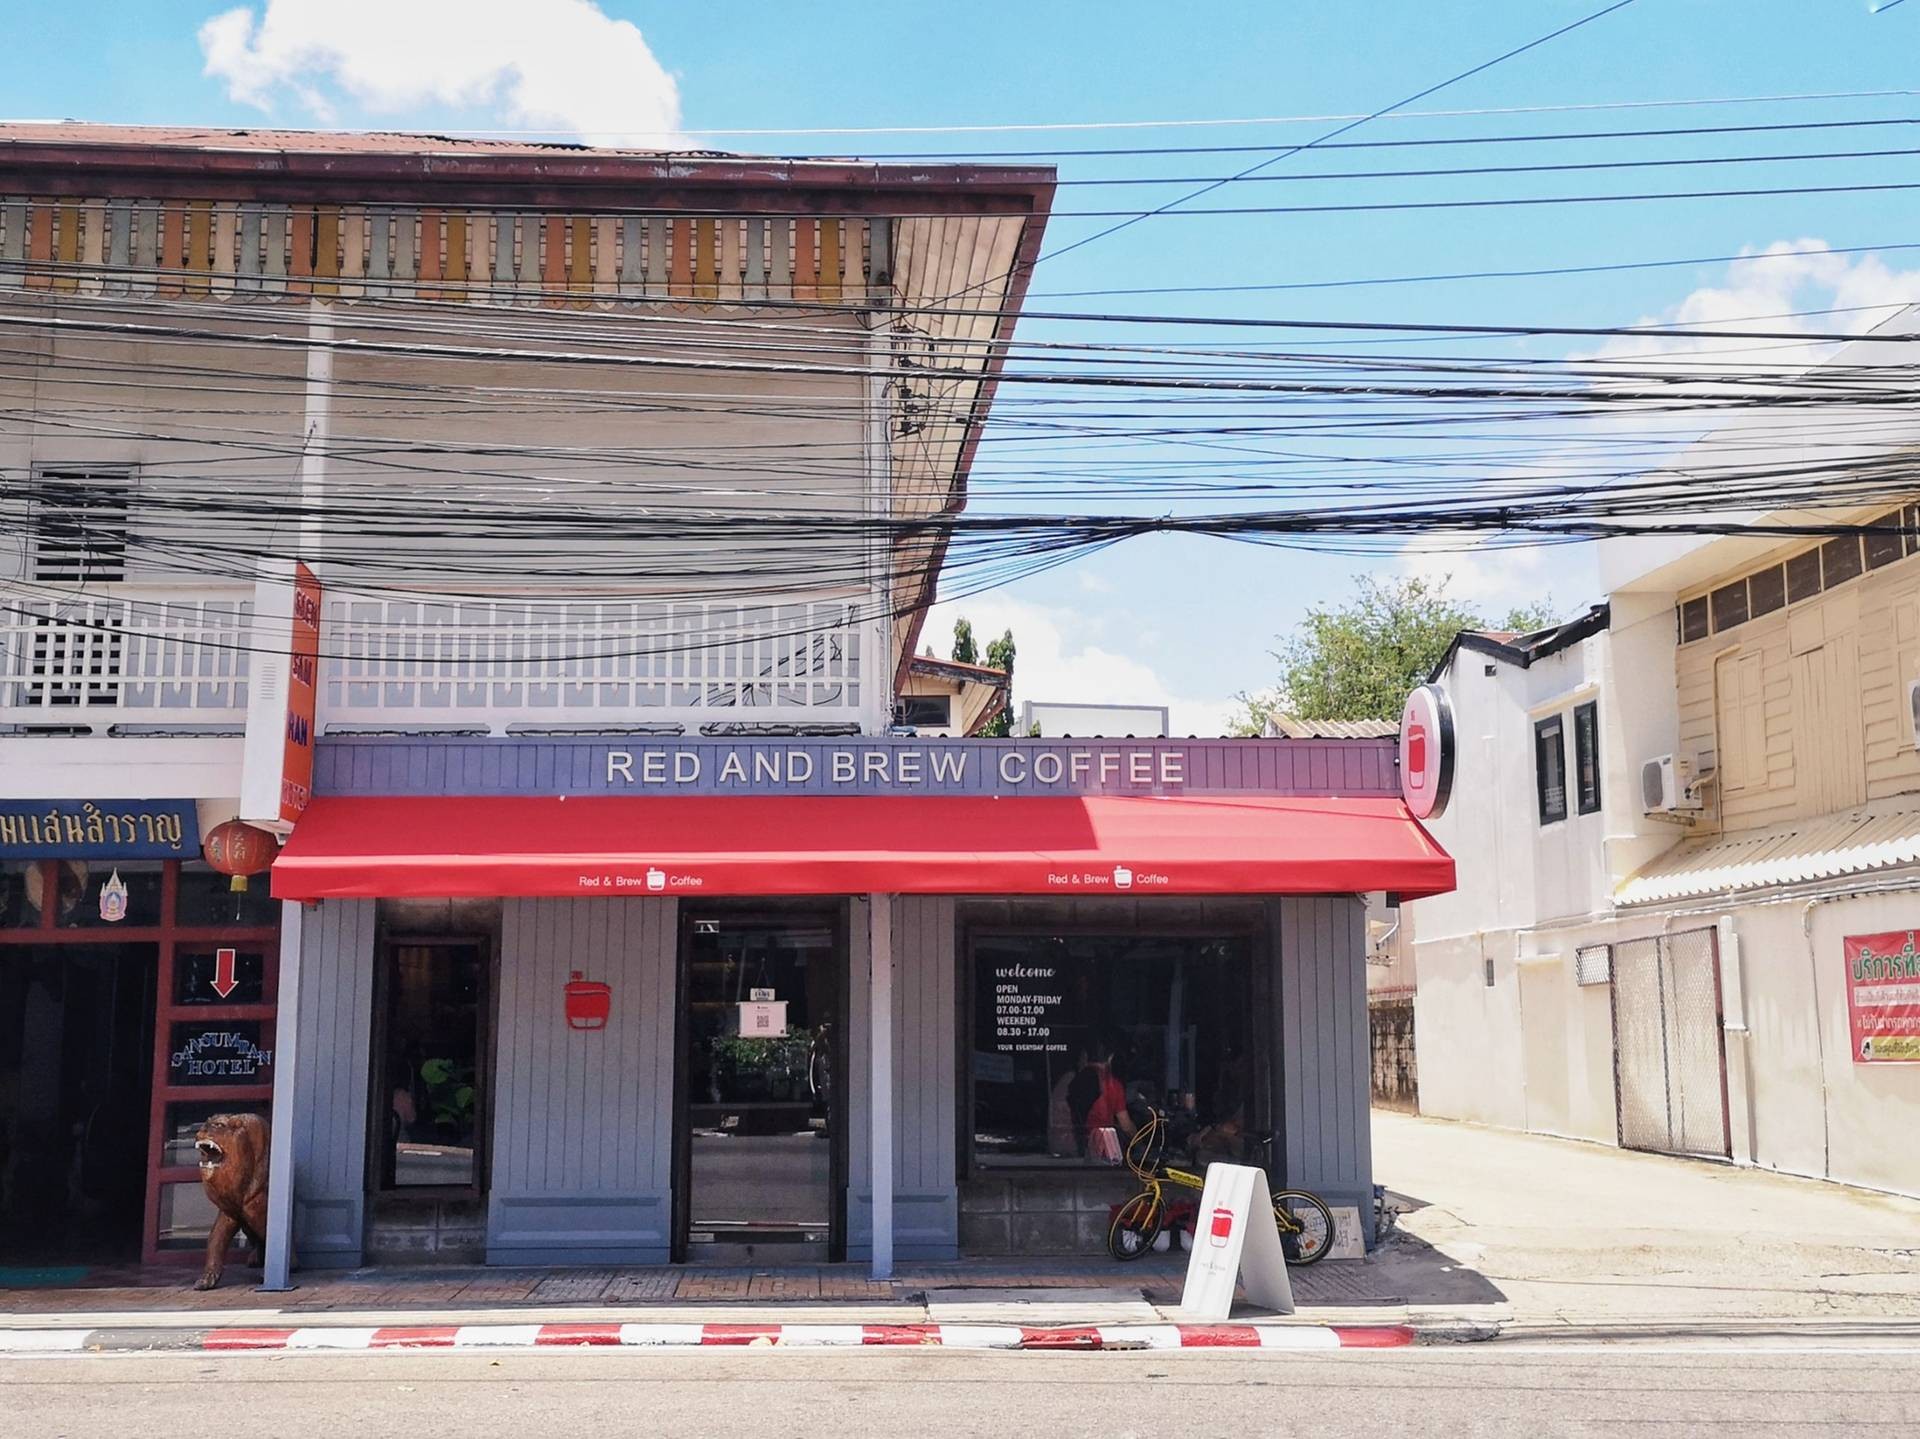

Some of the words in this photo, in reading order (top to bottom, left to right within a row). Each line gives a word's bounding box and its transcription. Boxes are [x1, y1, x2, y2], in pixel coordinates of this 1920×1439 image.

[607, 751, 700, 783] RED
[719, 751, 813, 783] AND
[832, 751, 967, 783] BREW
[1000, 752, 1184, 783] COFFEE
[579, 876, 600, 887] Red
[603, 877, 612, 887] &
[616, 876, 642, 887] Brew
[670, 876, 703, 886] Coffee
[1048, 874, 1068, 884] Red
[1072, 874, 1080, 884] &
[1084, 874, 1109, 884] Brew
[1136, 874, 1169, 884] Coffee
[995, 962, 1057, 978] welcome
[996, 984, 1019, 994] OPEN
[996, 995, 1062, 1005] MONDAY-FRIDAY
[996, 1005, 1045, 1015] 07.00-17.00
[996, 1016, 1037, 1026] WEEKEND
[997, 1027, 1021, 1037] 08.30
[1027, 1027, 1050, 1037] 17.00
[171, 1032, 273, 1068] SANSUMRAN
[187, 1059, 256, 1076] HOTEL
